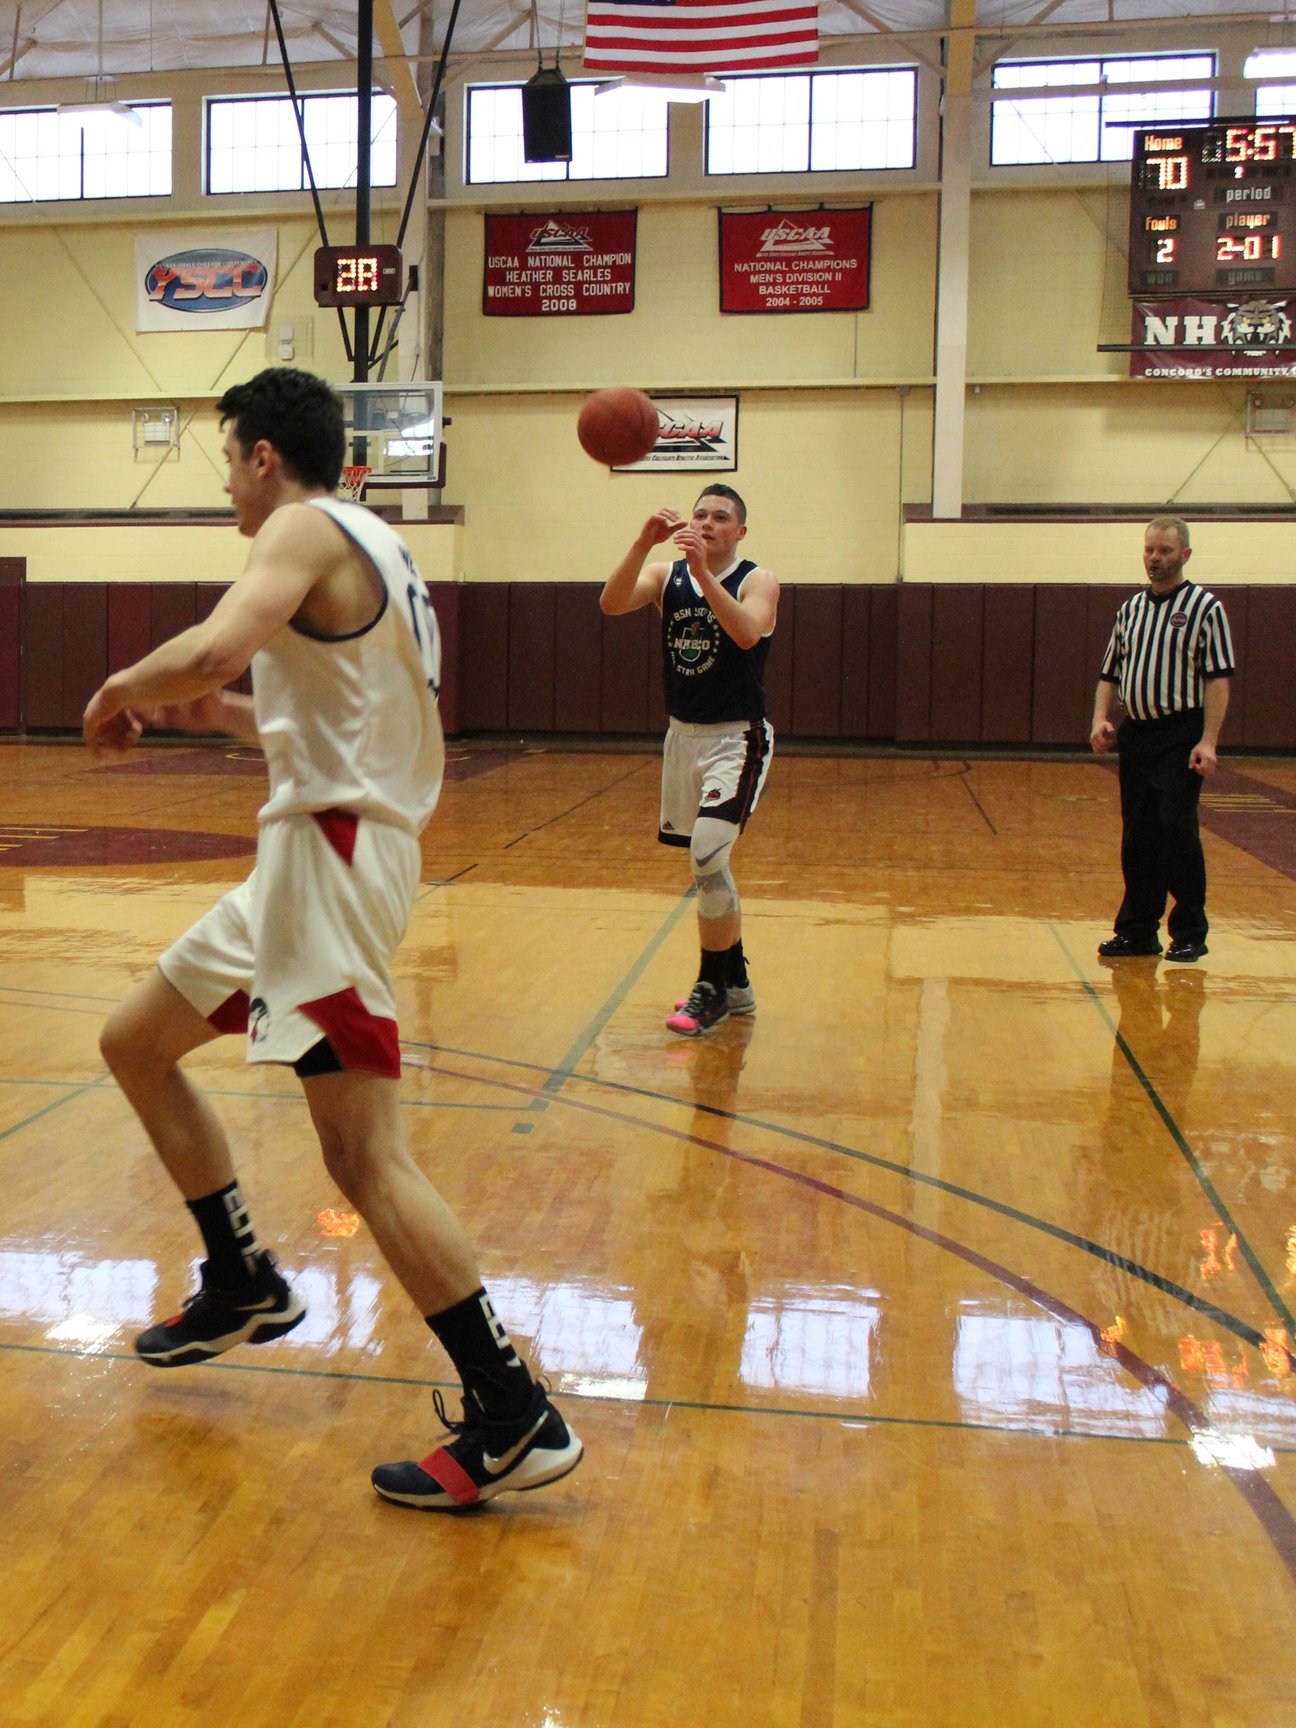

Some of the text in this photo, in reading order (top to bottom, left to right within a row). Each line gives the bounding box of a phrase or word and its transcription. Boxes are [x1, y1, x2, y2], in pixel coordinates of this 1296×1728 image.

[1145, 135, 1183, 151] Home
[1225, 126, 1296, 161] 5:57
[1146, 156, 1188, 190] 70
[1226, 186, 1271, 203] period
[1226, 212, 1270, 229] player
[760, 227, 831, 240] USCAA
[1157, 239, 1174, 263] 2
[488, 252, 632, 268] USCAA NATIONAL CHAMPION
[734, 259, 858, 272] NATIONAL CHAMPIONS
[149, 264, 262, 300] YSCC
[506, 268, 611, 282] HEATHER SEARLES
[750, 272, 842, 284] MEN'S DIVISION II
[488, 282, 630, 298] WOMEN'S CROSS COUNTRY
[759, 284, 831, 295] BASKETBALL
[541, 299, 577, 311] 2008
[766, 297, 790, 306] 2004
[799, 296, 824, 306] 2005
[1144, 368, 1212, 377] CONCORD'S
[674, 608, 692, 621] BSN
[676, 665, 695, 676] STAR
